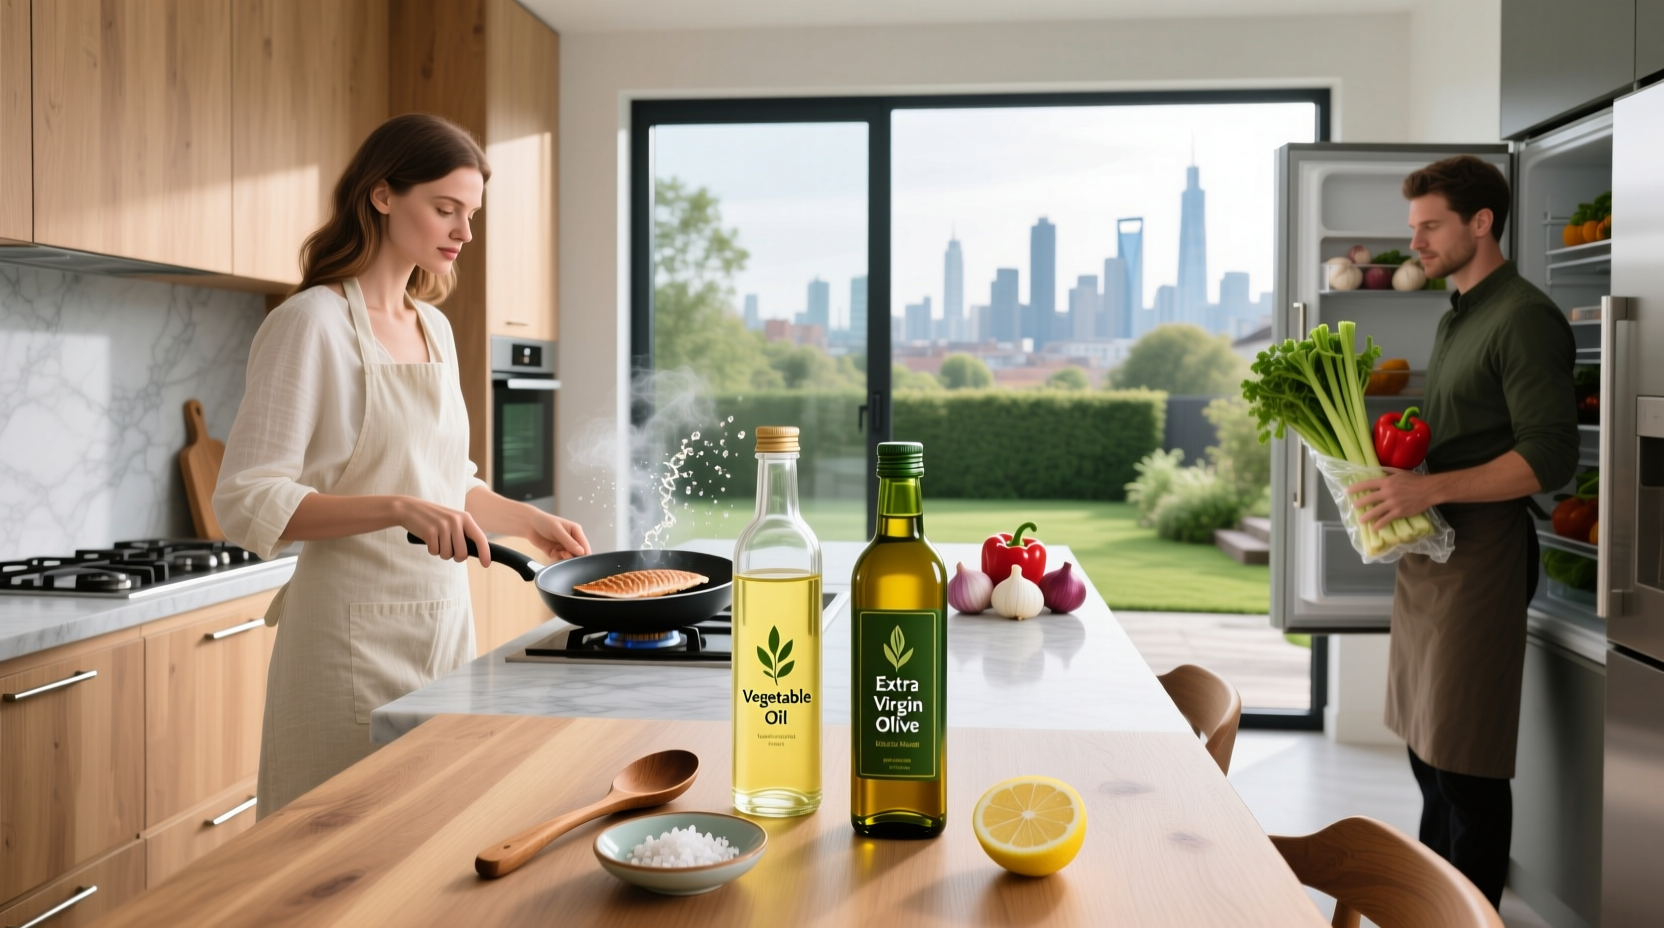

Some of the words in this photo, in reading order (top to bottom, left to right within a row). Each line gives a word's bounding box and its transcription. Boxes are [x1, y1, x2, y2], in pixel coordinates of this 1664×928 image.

[876, 676, 919, 692] Extra
[743, 689, 811, 707] Vegetable
[874, 695, 922, 716] Virgin
[765, 710, 787, 725] Oil
[875, 716, 920, 733] Olive
